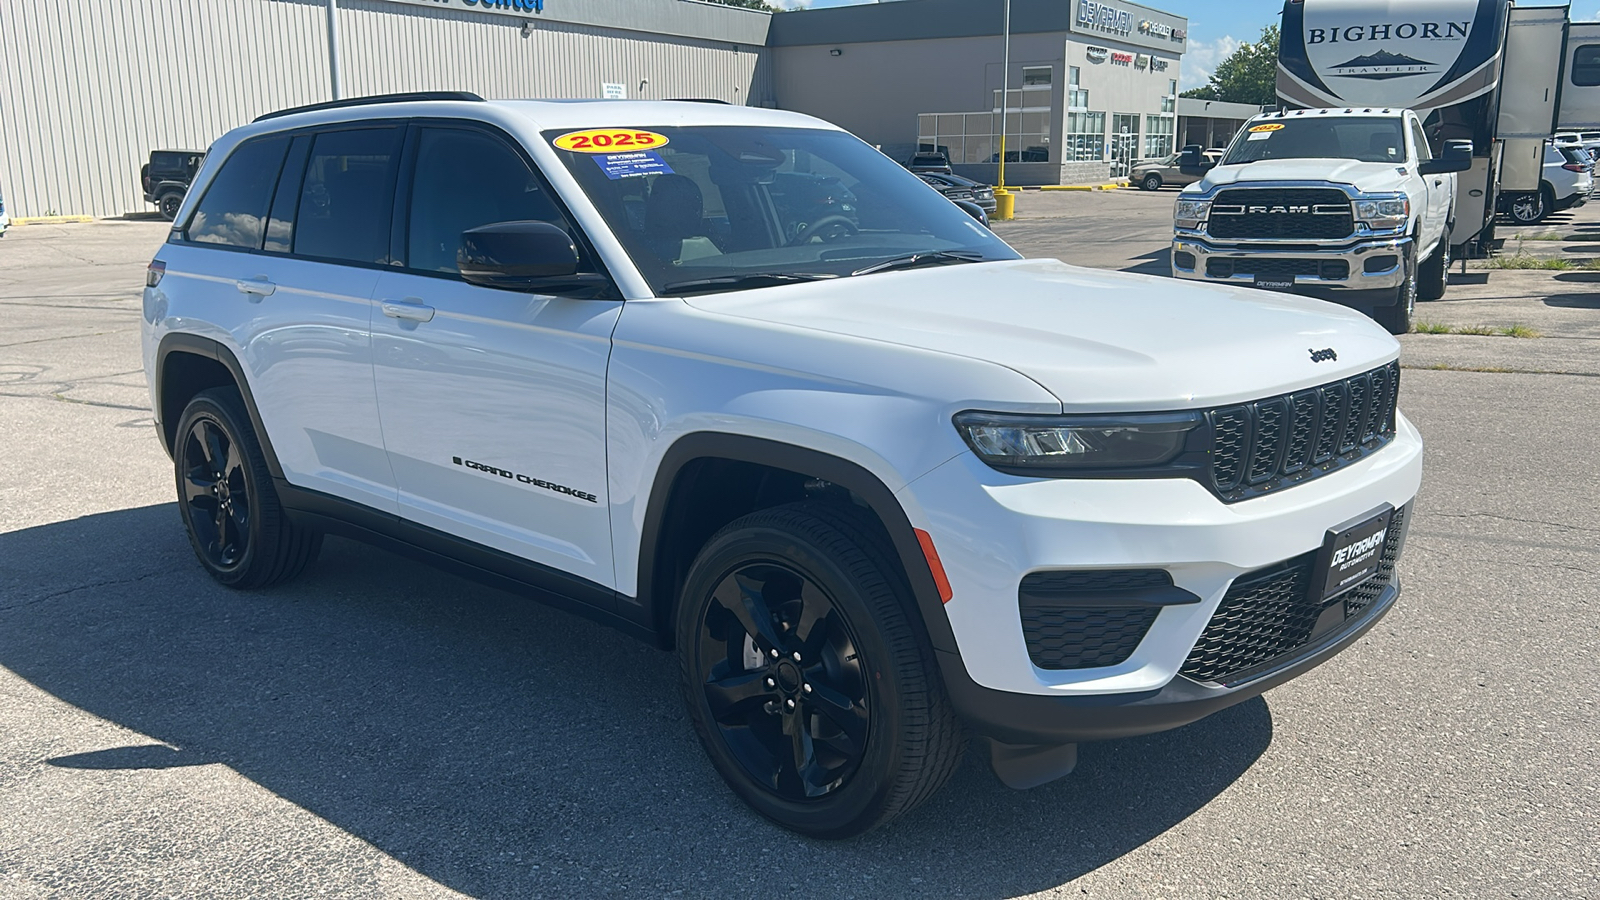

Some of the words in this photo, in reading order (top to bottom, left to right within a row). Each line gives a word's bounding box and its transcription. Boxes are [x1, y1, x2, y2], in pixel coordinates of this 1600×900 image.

[1078, 0, 1134, 34] DEYARMAN
[1307, 21, 1471, 45] BIGHORN
[1336, 65, 1428, 74] TRAVELER
[1251, 124, 1282, 132] 2024
[570, 133, 655, 149] 2025
[1248, 205, 1309, 214] RAM
[1256, 280, 1293, 288] DEYARMAN
[1308, 347, 1337, 363] Jeep
[465, 460, 514, 479] GRAND
[516, 473, 598, 503] CHEROKEE
[1330, 527, 1388, 568] DEYARMAN
[1339, 548, 1376, 572] AUTOMOTIVE
